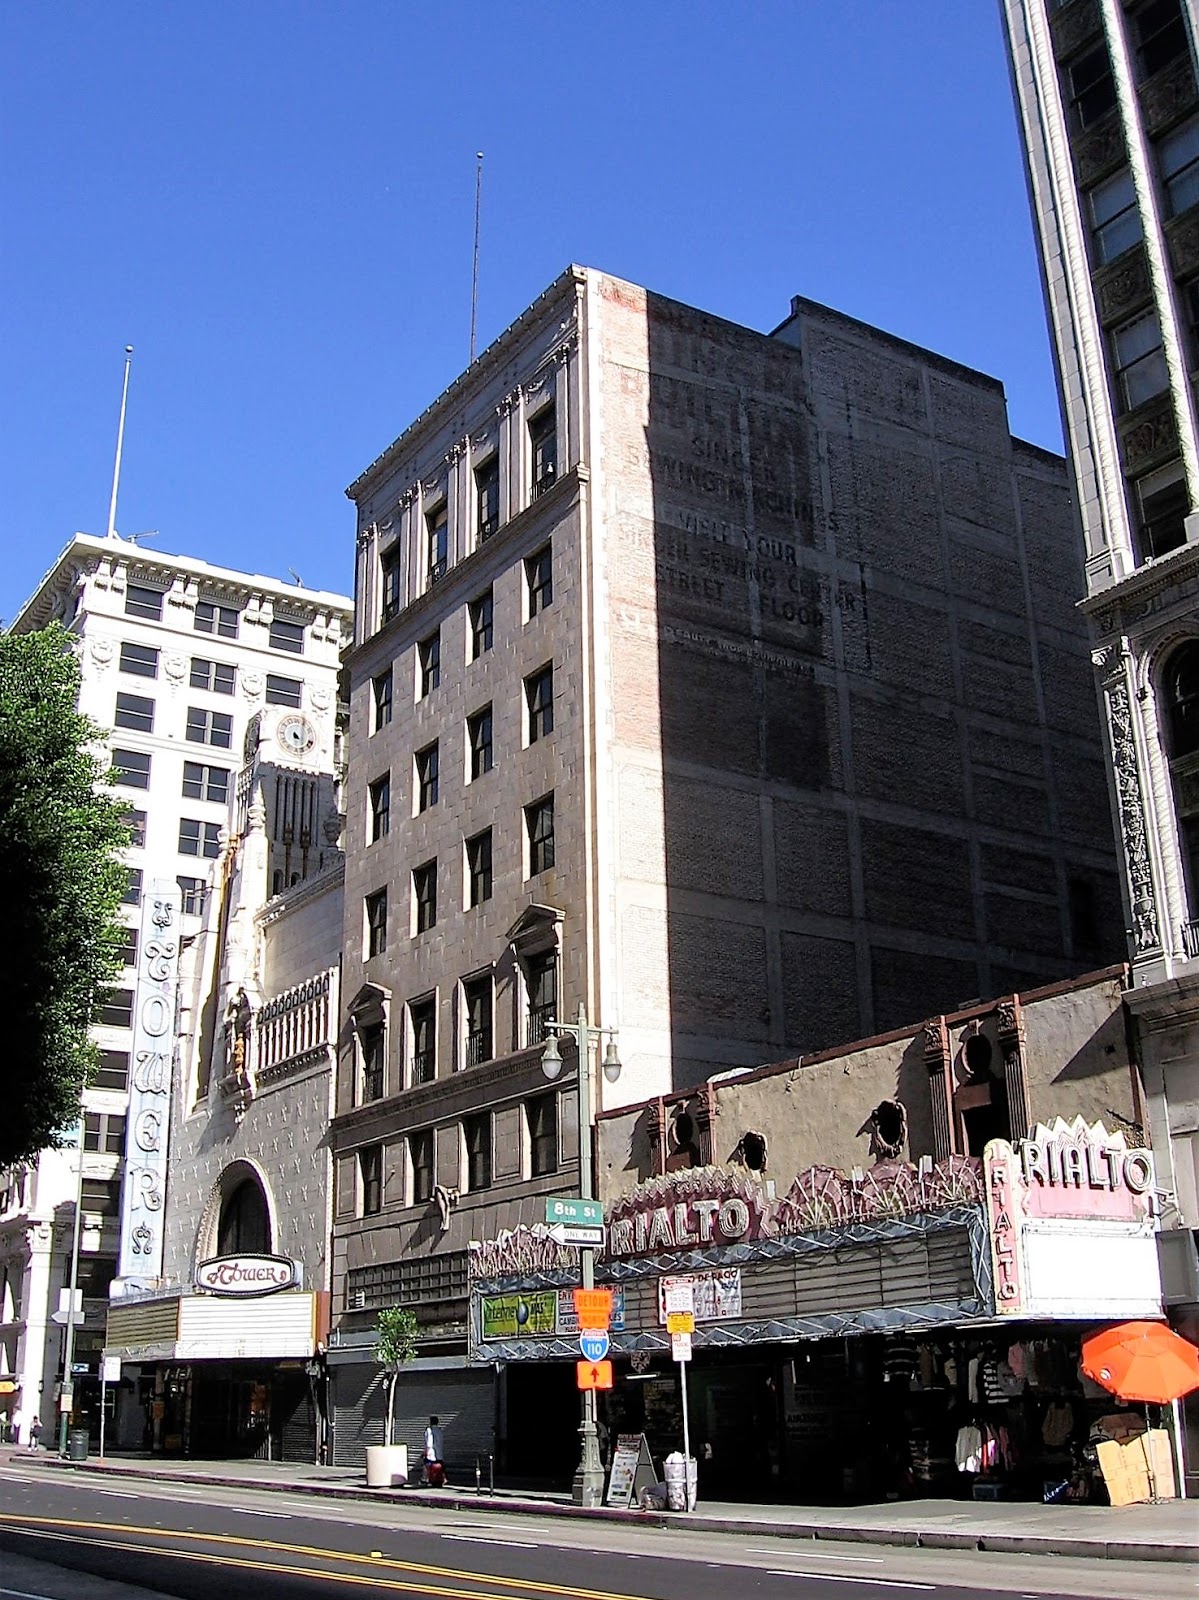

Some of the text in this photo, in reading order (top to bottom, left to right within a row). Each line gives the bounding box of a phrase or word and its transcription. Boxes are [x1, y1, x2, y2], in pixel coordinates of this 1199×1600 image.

[743, 529, 799, 567] YOUR
[759, 594, 825, 628] FLOOR
[1022, 1140, 1152, 1196] RIALTO
[554, 1201, 596, 1218] 8th St
[564, 1230, 598, 1240] ONE WAY
[610, 1198, 751, 1256] RIALTO
[993, 1166, 1018, 1300] RIALTO
[578, 1295, 609, 1307] DETOUR
[582, 1315, 606, 1325] NORTH
[587, 1343, 603, 1355] 110
